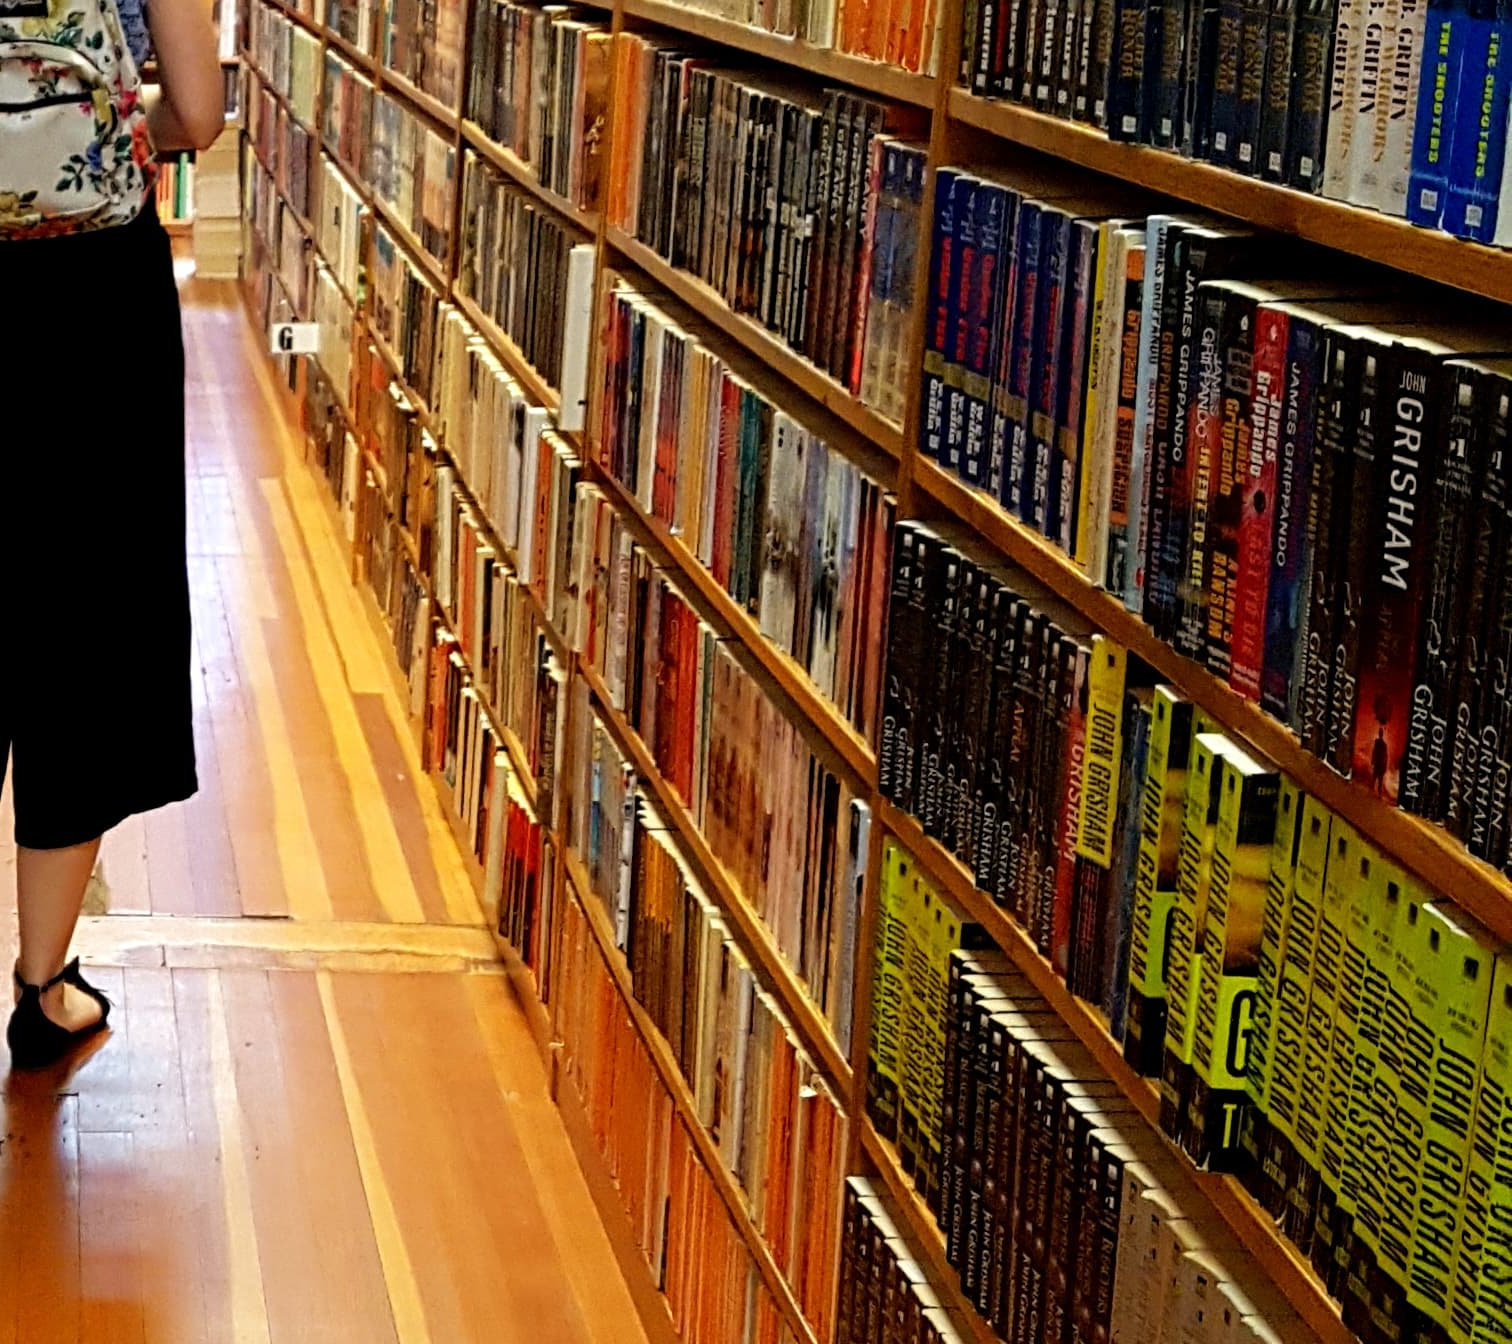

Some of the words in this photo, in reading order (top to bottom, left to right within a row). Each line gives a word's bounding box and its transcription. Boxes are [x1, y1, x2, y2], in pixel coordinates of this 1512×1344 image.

[1330, 22, 1351, 114] GRIFFIN
[1359, 22, 1384, 115] GRIFFIN
[1390, 26, 1415, 121] GRIFFIN
[1440, 20, 1454, 54] THE
[1427, 59, 1448, 165] SHOOTERS
[1474, 73, 1496, 179] SHOOTERS
[277, 326, 294, 352] G
[1180, 270, 1195, 340] JAMES
[1171, 342, 1190, 463] GRIPPANDO
[1247, 369, 1271, 480] Grippando
[1263, 392, 1283, 463] James
[1286, 361, 1302, 438] JAMES
[1399, 369, 1428, 395] JOHN
[1218, 396, 1241, 498] Grippando
[1380, 396, 1426, 591] GRISHAM
[1191, 519, 1205, 541] TO
[1275, 441, 1297, 568] GRIPPANDO
[1206, 549, 1225, 641] RANSOM
[1090, 702, 1117, 758] JOHN
[1313, 656, 1331, 727] JOHN
[1340, 671, 1358, 740] JOHN
[879, 715, 897, 787] GRISHAM
[1404, 683, 1435, 800] GRISHAM
[1426, 715, 1448, 786] JOHN
[1447, 700, 1471, 821] GRISHAM
[1461, 736, 1478, 806] JOHN
[1471, 724, 1501, 847] GRISHAM
[974, 802, 997, 880] GRISHAM
[1056, 742, 1086, 863] GRISHAM
[1081, 759, 1111, 857] GRISHAM
[1140, 775, 1163, 846] JOHN
[1488, 756, 1511, 835] JOHN
[1178, 829, 1203, 902] JOHN
[1208, 851, 1231, 927] JOHN
[1264, 869, 1287, 952] JOHN
[885, 912, 907, 971] JOHN
[1130, 852, 1157, 984] GRISHAM
[1285, 894, 1318, 971] JOHN
[1312, 915, 1343, 1003] JOHN
[877, 971, 902, 1077] GRISHAM
[1166, 905, 1194, 1050] GRISHAM
[1193, 933, 1224, 1072] GRISHAM
[1338, 936, 1368, 1025] JOHN
[1357, 956, 1389, 1047] JOHN
[1248, 956, 1277, 1097] GRISHAM
[1268, 975, 1307, 1126] GRISHAM
[1399, 1005, 1436, 1103] JOHN
[1295, 1003, 1334, 1157] GRISHAM
[1320, 1026, 1357, 1177] GRISHAM
[1428, 1037, 1476, 1140] JOHN
[1472, 1076, 1504, 1170] JOHN
[1340, 1052, 1378, 1203] GRISHAM
[1355, 1076, 1399, 1238] GRISHAM
[1378, 1106, 1424, 1273] GRISHAM
[1408, 1134, 1466, 1312] GRISHAM
[1449, 1171, 1491, 1335] GRISHAM
